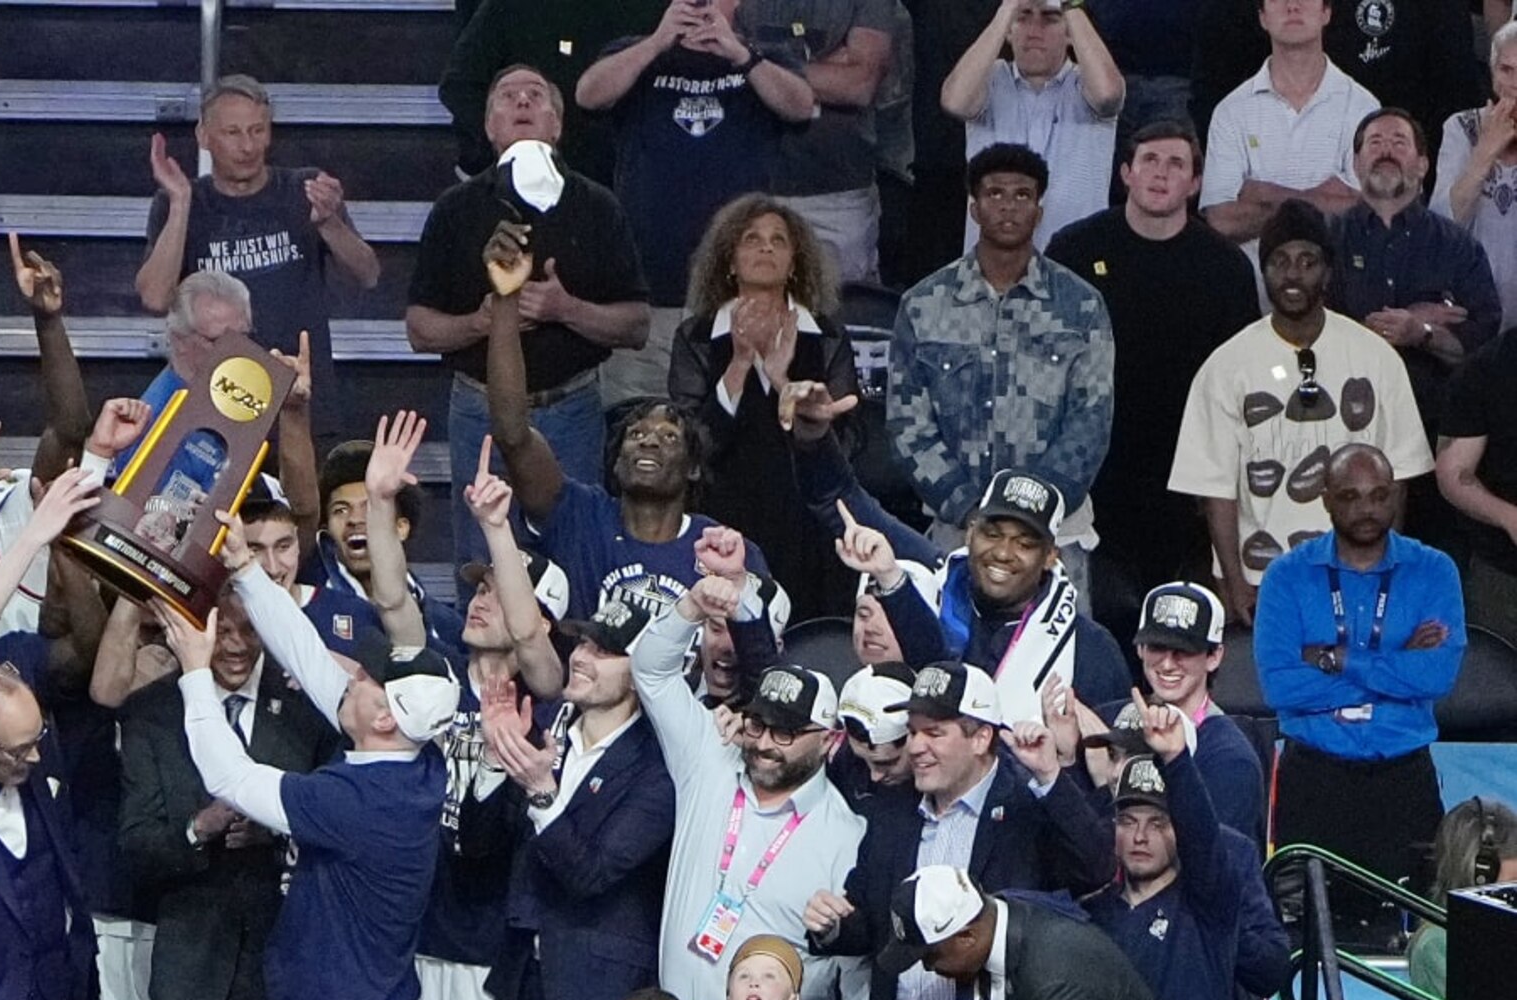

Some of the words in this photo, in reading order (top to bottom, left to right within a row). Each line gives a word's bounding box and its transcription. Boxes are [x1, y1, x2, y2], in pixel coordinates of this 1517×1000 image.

[209, 241, 230, 257] WE
[233, 237, 263, 255] JUST
[265, 230, 291, 250] WIN
[197, 244, 304, 273] CHAMPIONSHIPS.
[103, 533, 147, 567] NATIONAL
